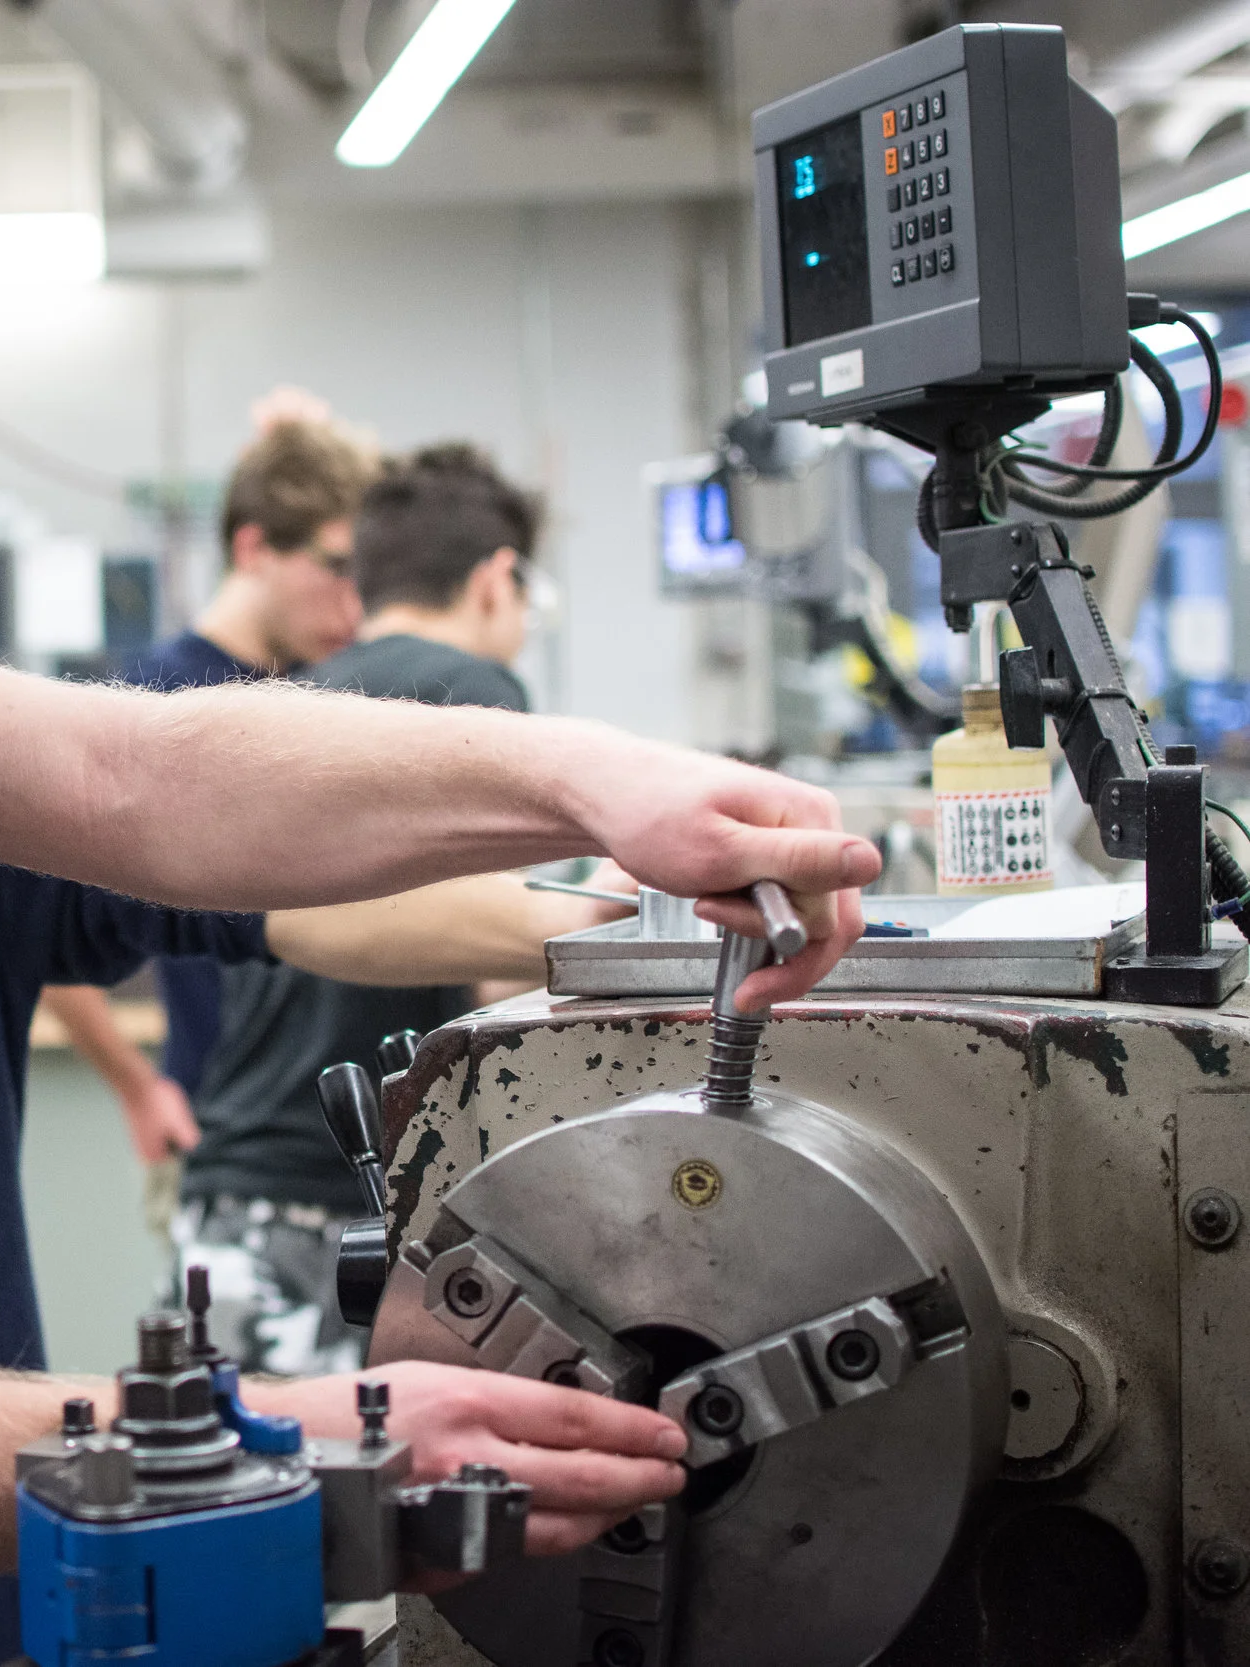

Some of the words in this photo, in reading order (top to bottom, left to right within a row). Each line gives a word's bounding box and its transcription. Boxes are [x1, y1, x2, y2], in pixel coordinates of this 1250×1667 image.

[900, 108, 908, 127] 7
[916, 103, 924, 121] 8
[932, 97, 940, 114] 9
[902, 146, 910, 162] 4
[919, 140, 927, 158] 5
[934, 135, 943, 152] 6
[905, 184, 911, 201] 1
[921, 178, 929, 196] 2
[937, 173, 945, 190] 3
[906, 222, 915, 240] 0
